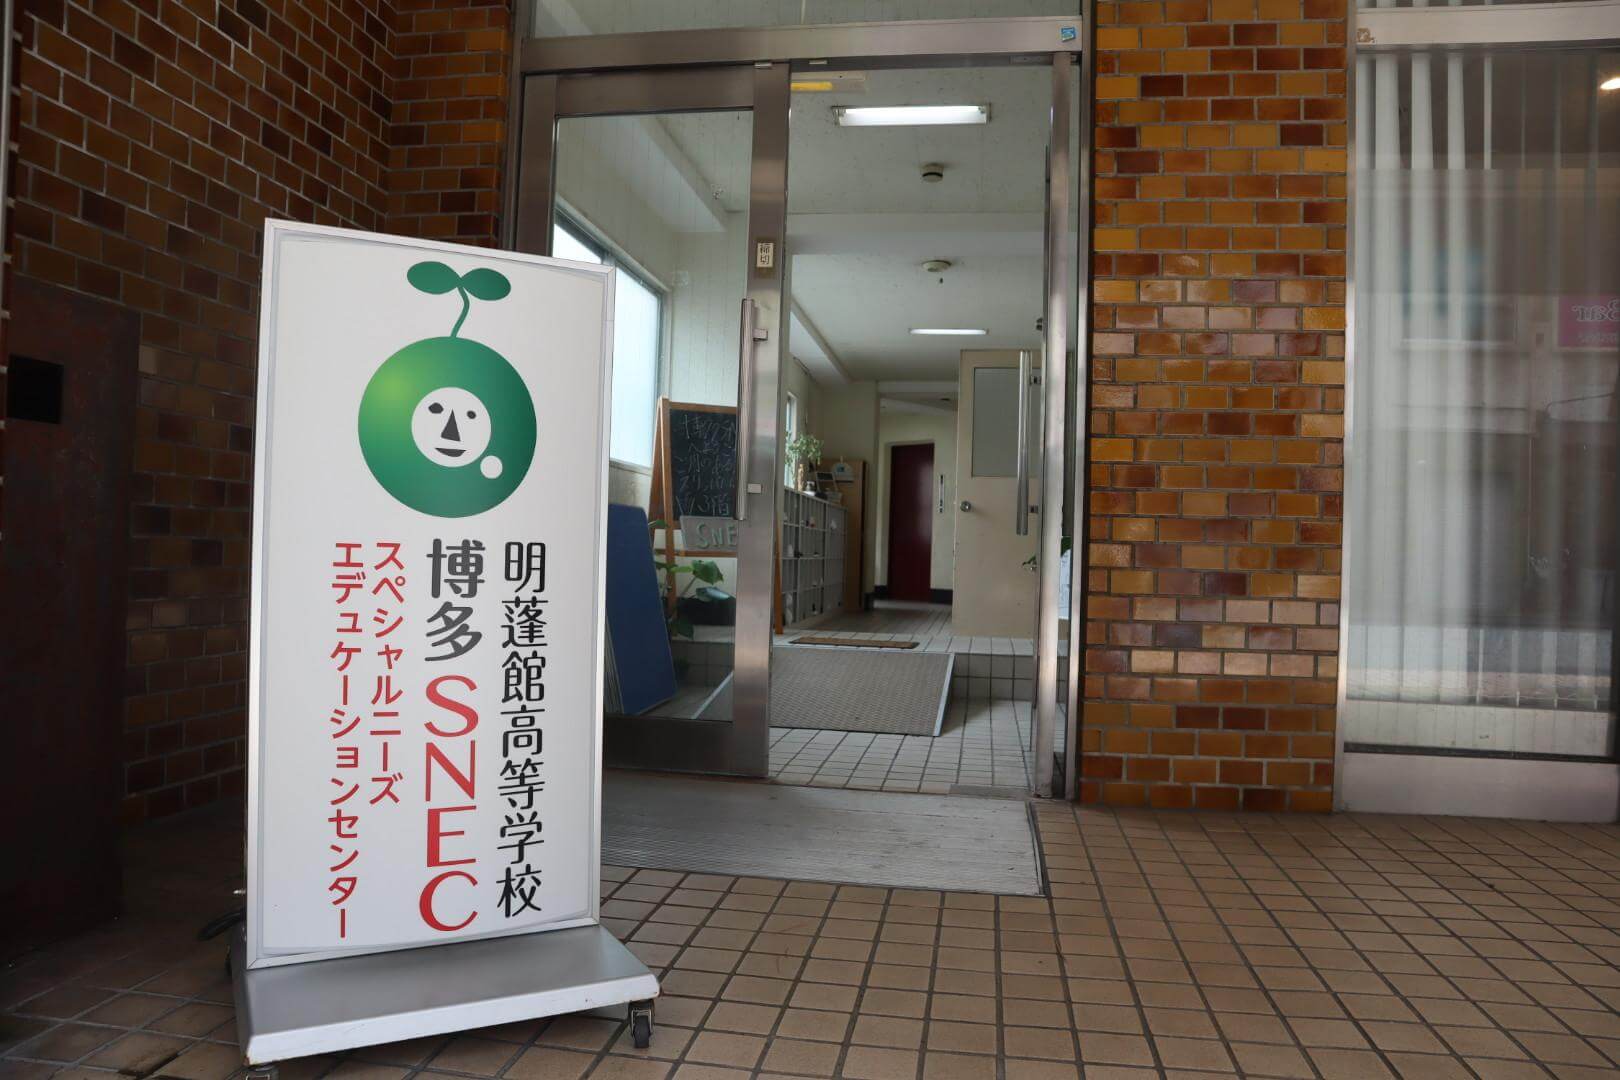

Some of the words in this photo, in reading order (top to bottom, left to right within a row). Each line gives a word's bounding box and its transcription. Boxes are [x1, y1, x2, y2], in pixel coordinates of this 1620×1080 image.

[328, 542, 367, 939] エデュケーションセンター
[370, 542, 406, 805] スペシャルニーズ
[496, 541, 549, 918] 明蓬館高等学校
